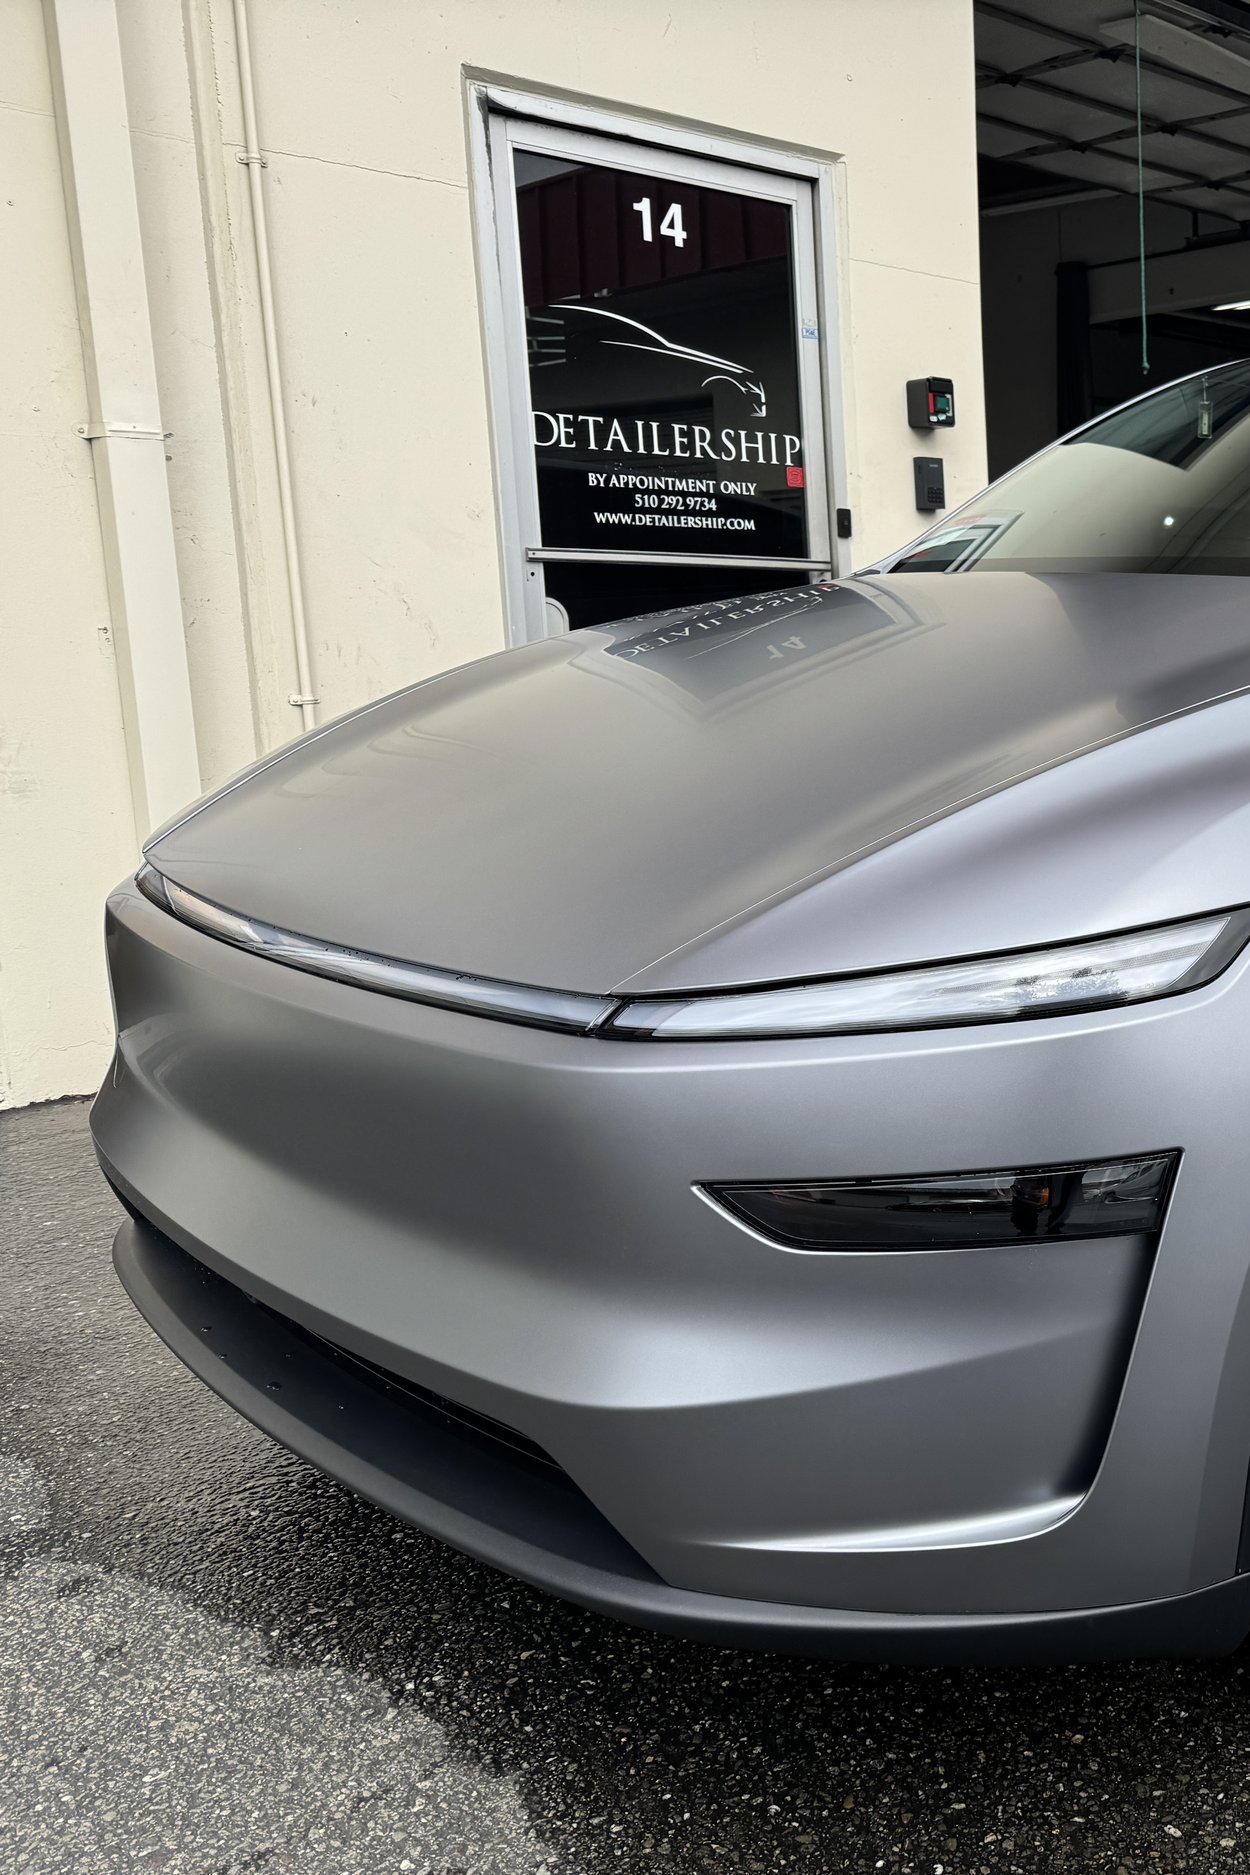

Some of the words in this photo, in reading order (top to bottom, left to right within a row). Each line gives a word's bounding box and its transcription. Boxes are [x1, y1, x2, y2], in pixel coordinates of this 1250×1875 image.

[632, 197, 687, 248] 14
[532, 411, 800, 466] DETAILERSHIP
[588, 472, 607, 488] BY
[609, 474, 716, 494] APPOINTMENT
[720, 480, 757, 496] ONLY
[634, 494, 658, 509] 510
[660, 495, 685, 511] 292
[686, 497, 717, 512] 9734
[593, 512, 756, 531] WWW.DETAILERSHIP.COM
